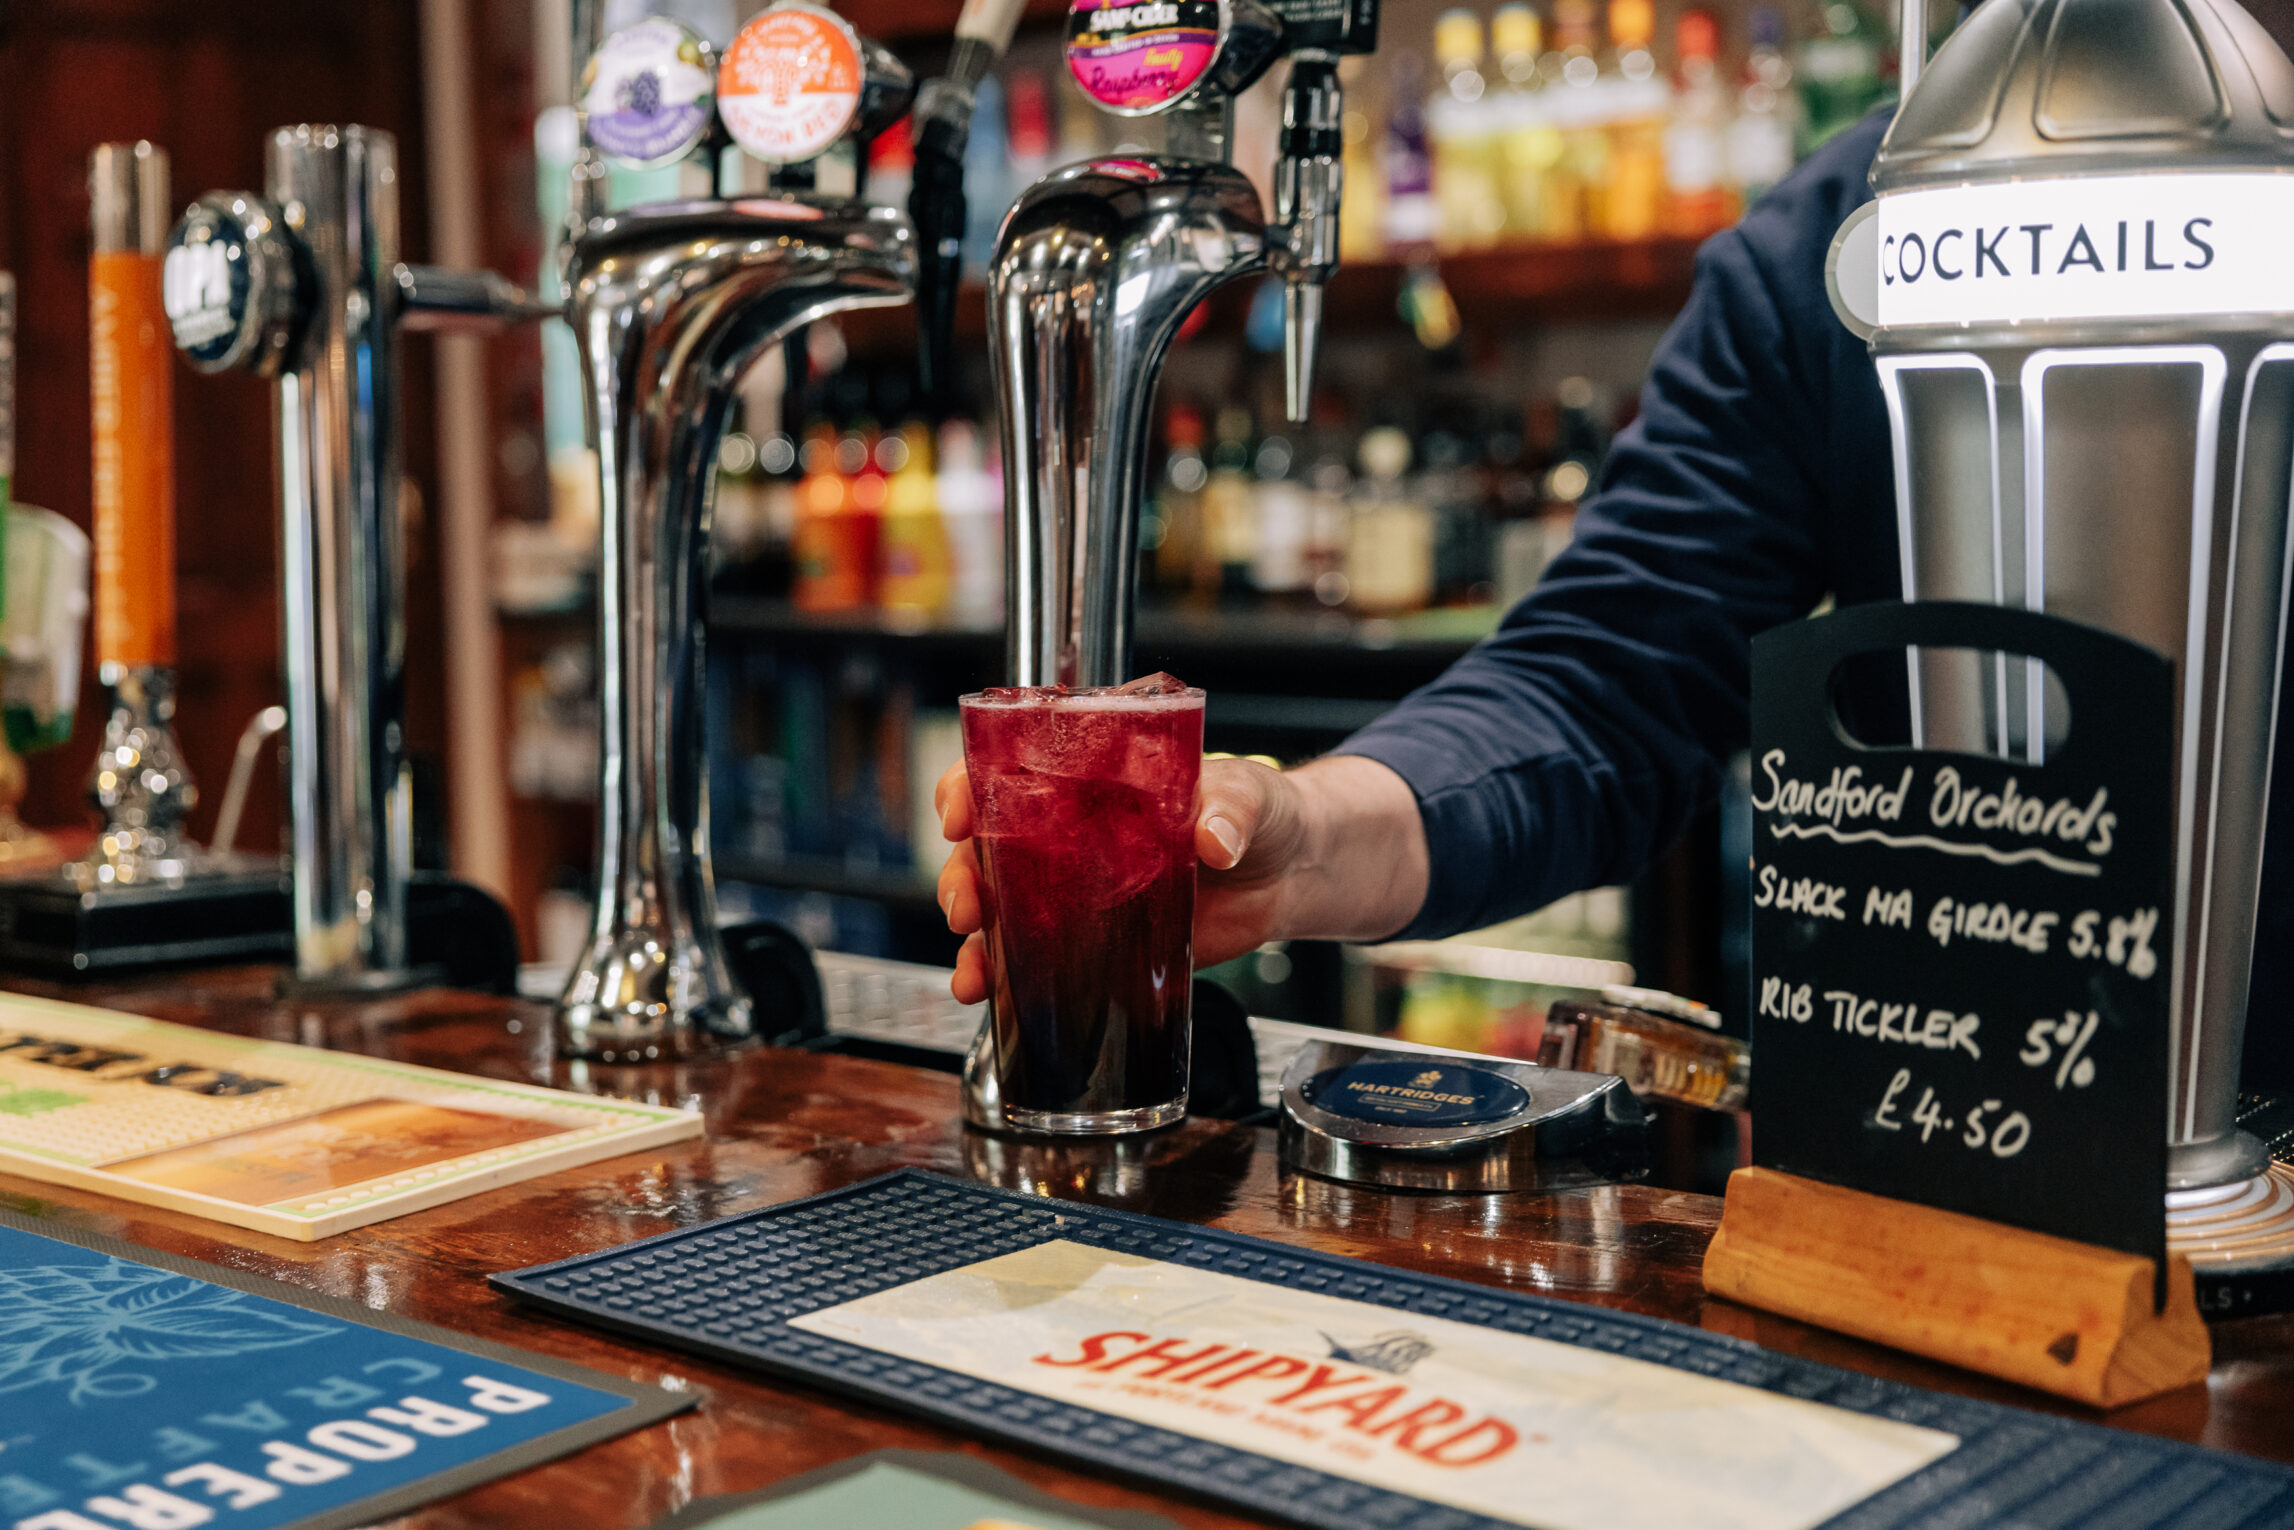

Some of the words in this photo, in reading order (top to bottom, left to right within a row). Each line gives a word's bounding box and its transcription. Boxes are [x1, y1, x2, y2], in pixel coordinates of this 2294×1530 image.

[1882, 217, 2215, 286] COCKTAILS
[1752, 749, 1914, 827] Sandford
[1929, 766, 2117, 855] Orchards
[1754, 864, 1847, 921] SLACK
[1759, 976, 1813, 1023] RIB
[1823, 990, 1981, 1060] TICKLER
[2019, 1011, 2099, 1089] 5%
[1347, 1081, 1476, 1105] HARTRIDGES
[1875, 1068, 2031, 1158] £4.50
[1031, 1330, 1520, 1468] SHIPYARD
